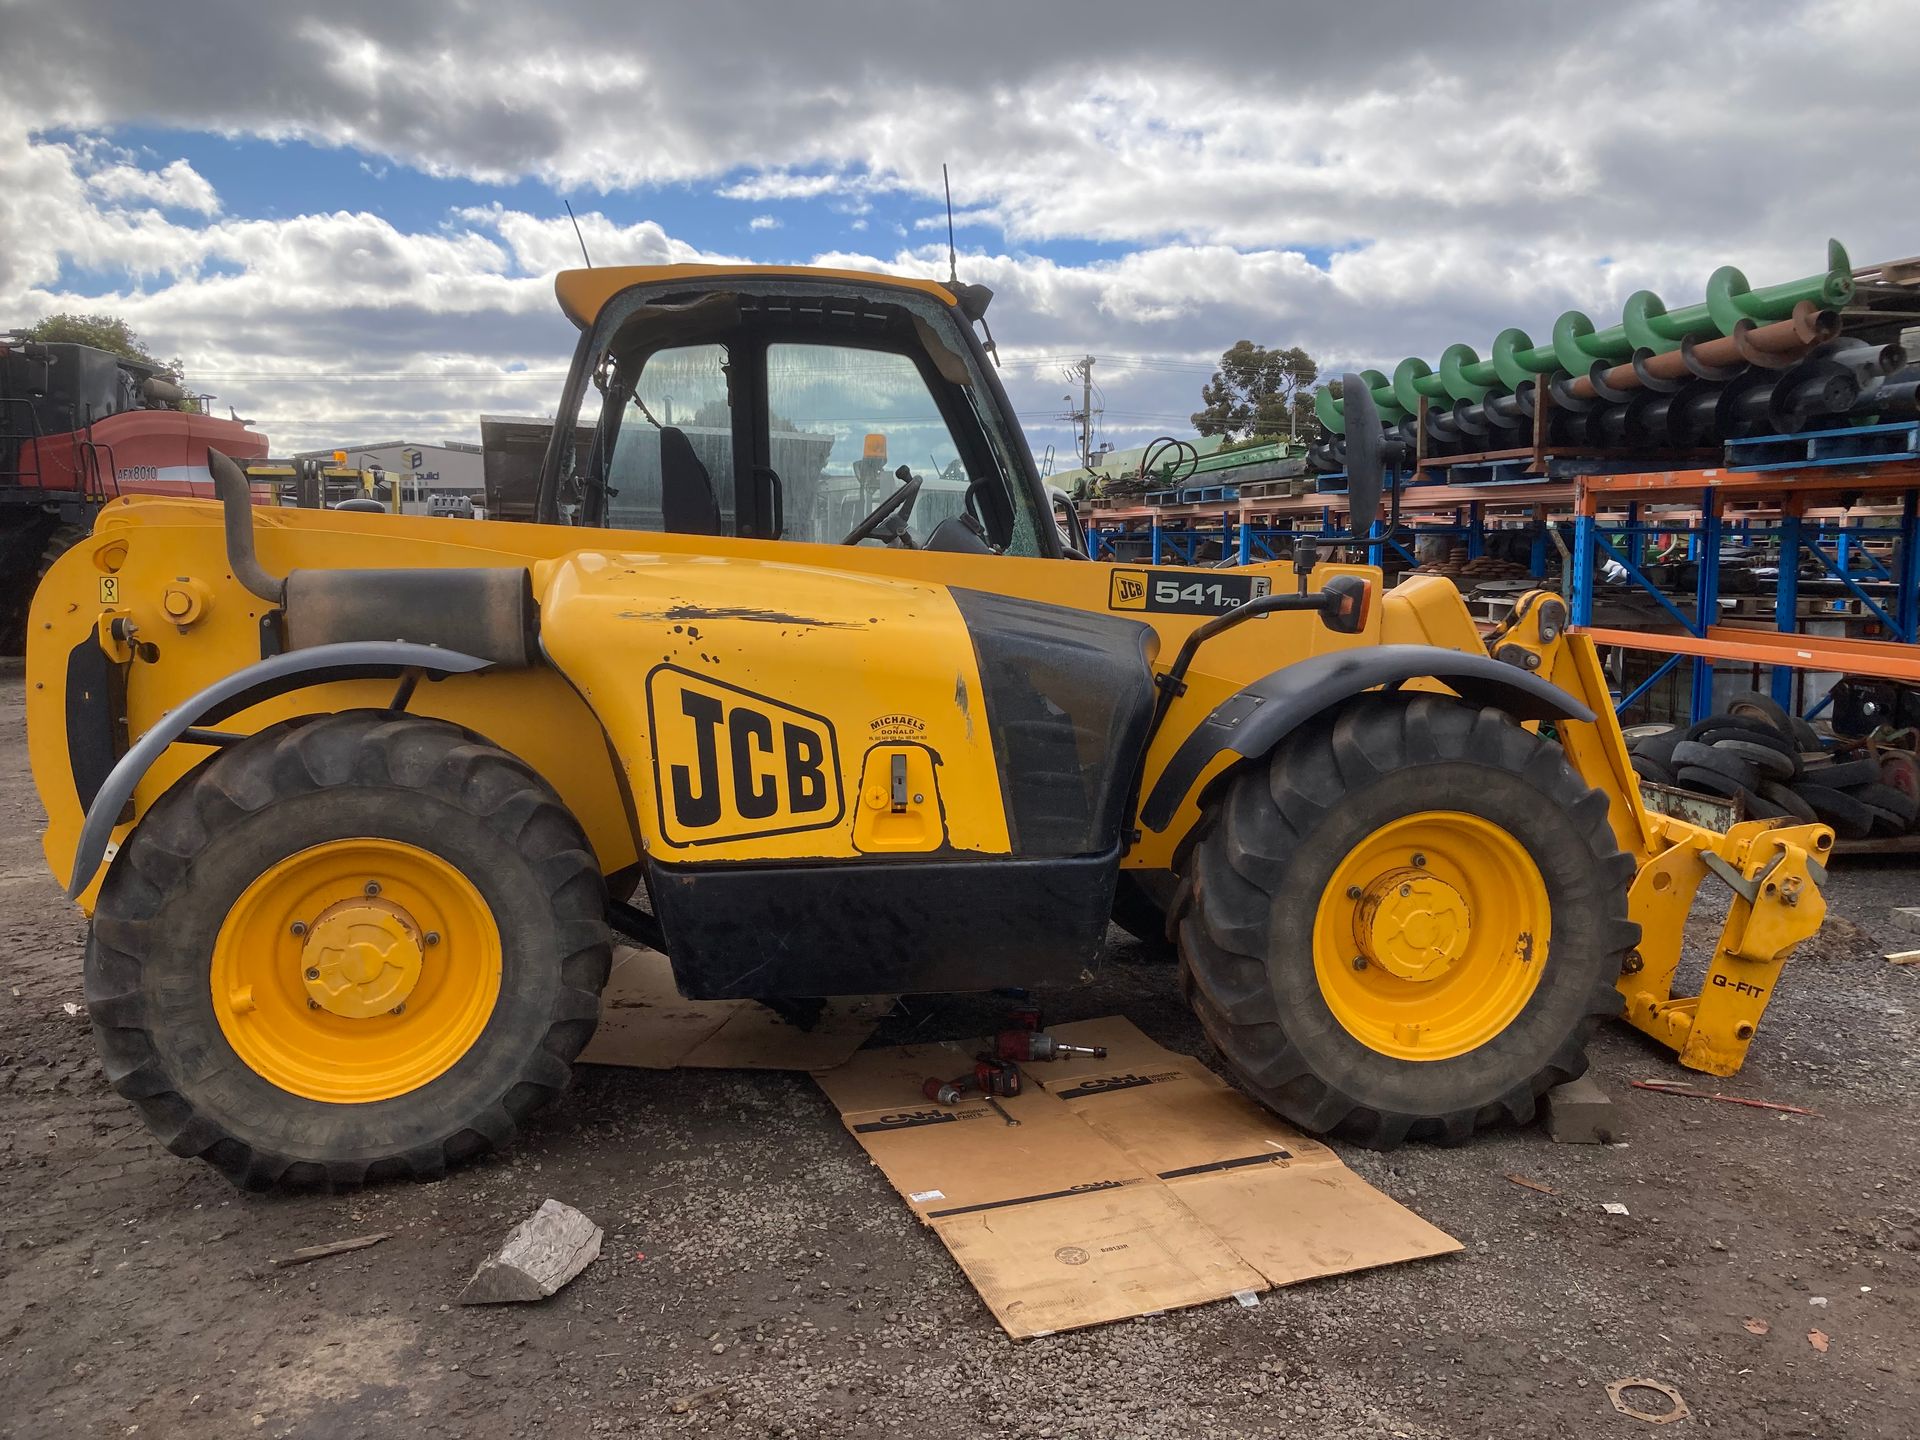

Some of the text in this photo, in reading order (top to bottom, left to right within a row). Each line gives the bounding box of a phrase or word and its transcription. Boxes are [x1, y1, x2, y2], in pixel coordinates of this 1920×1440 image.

[1120, 579, 1143, 600] JCB
[870, 716, 925, 730] MICHAELS
[671, 687, 827, 828] JCB
[1712, 974, 1765, 998] Q-FIT
[880, 1109, 945, 1124] CNH
